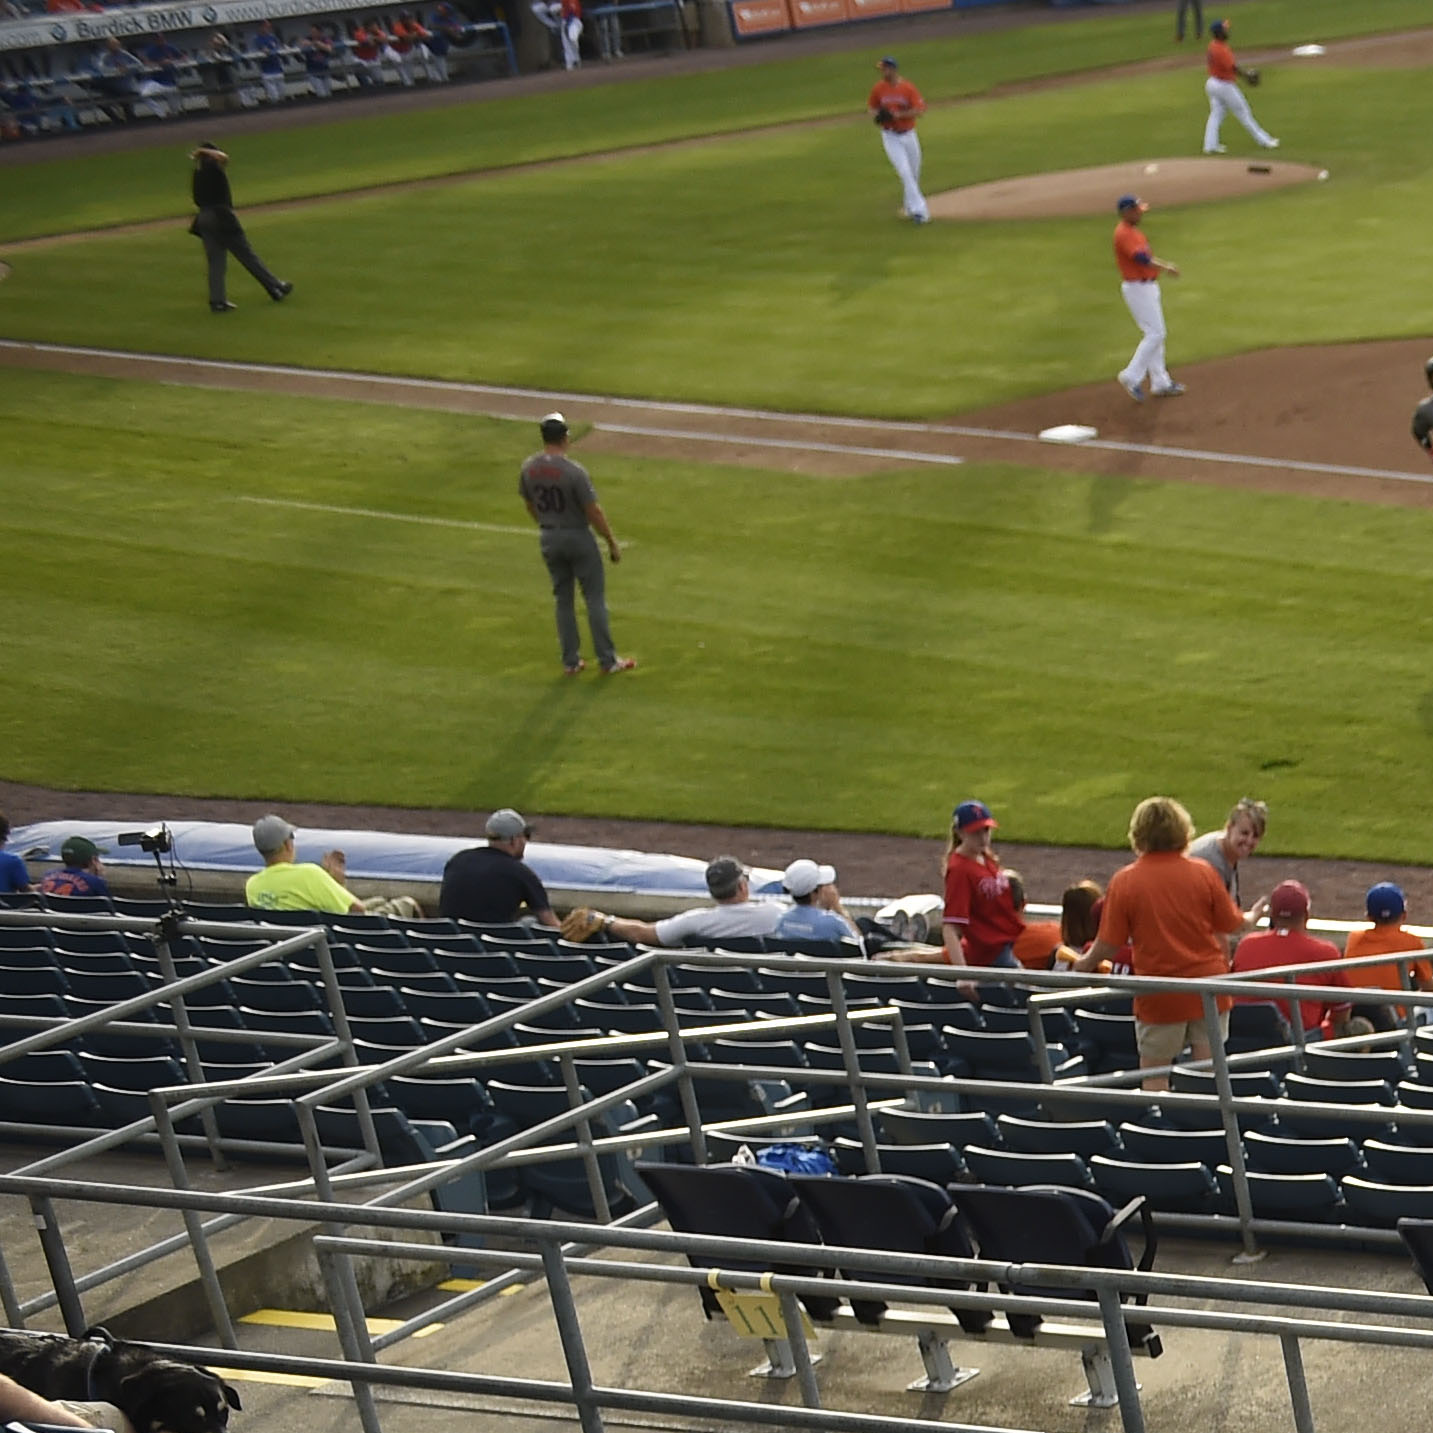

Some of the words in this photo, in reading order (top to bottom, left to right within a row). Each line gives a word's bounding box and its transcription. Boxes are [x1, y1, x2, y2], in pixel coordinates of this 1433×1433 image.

[77, 17, 145, 38] Burdick
[147, 9, 193, 31] BMW
[535, 484, 566, 513] 30
[731, 1304, 783, 1335] 11
